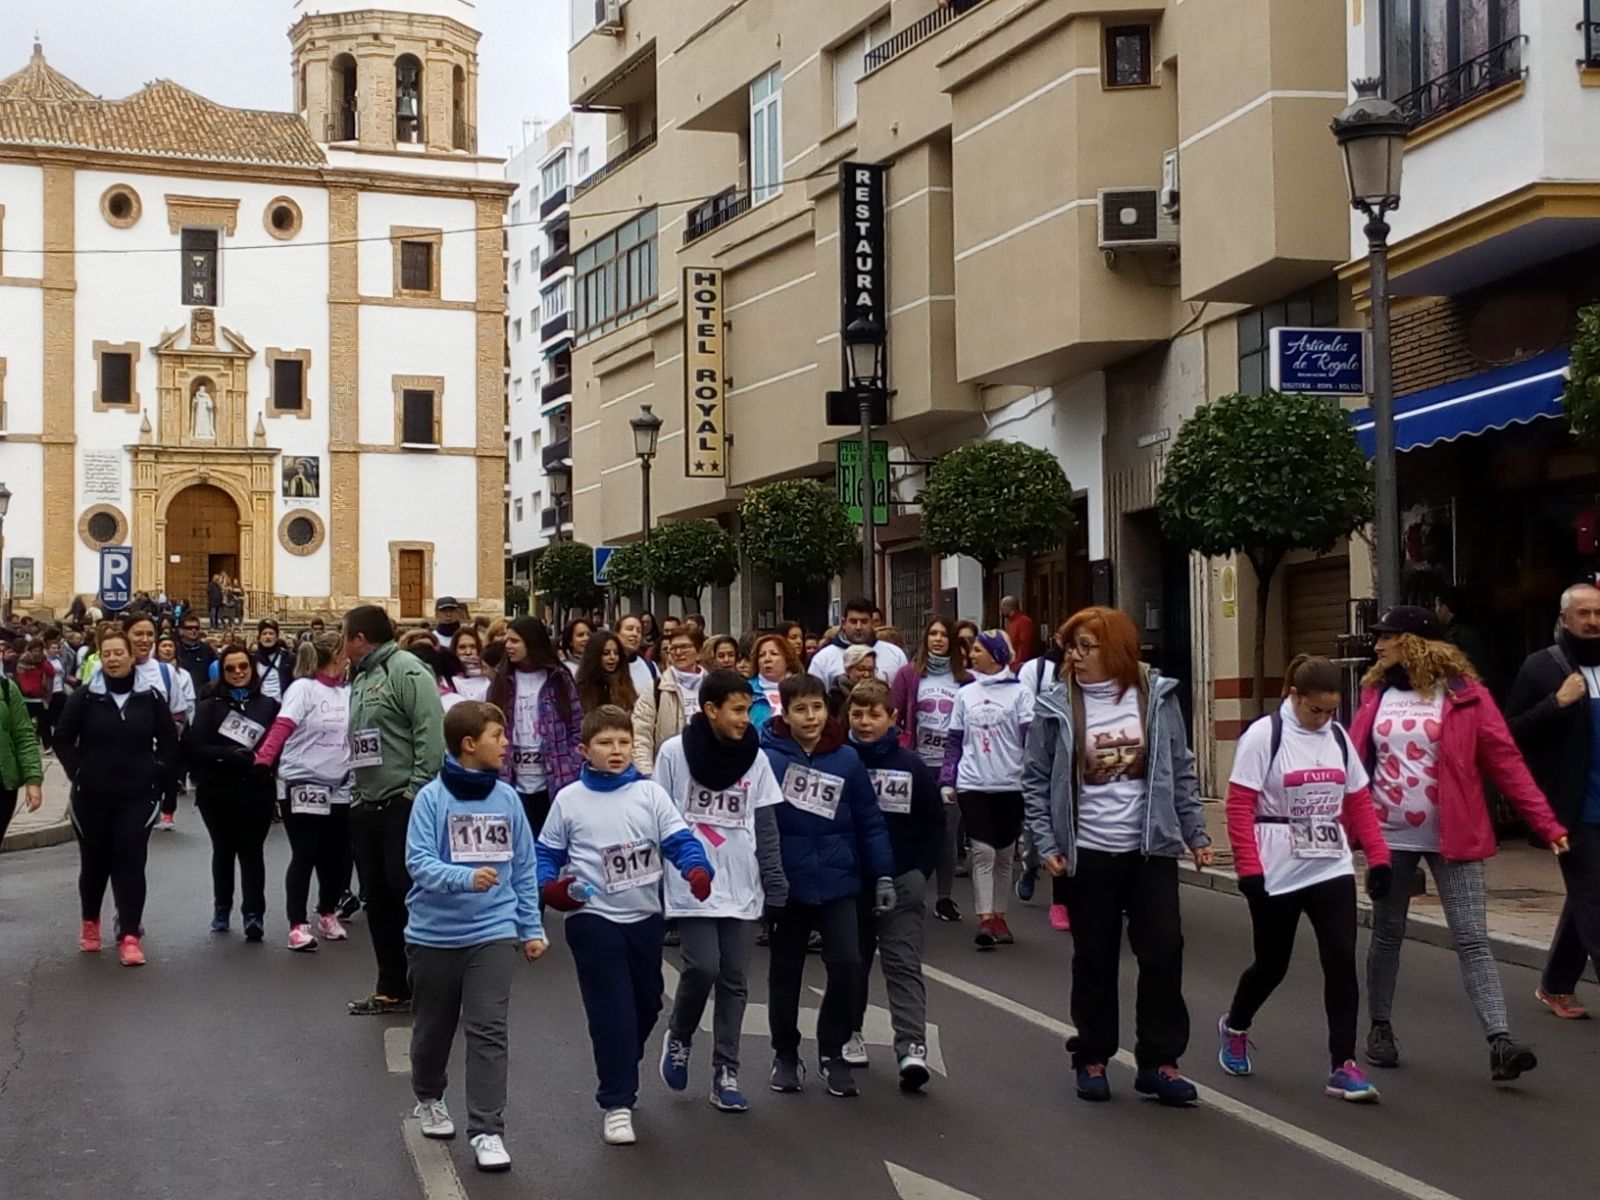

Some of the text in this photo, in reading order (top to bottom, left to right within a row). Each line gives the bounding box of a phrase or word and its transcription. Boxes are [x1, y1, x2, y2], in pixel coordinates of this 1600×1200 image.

[855, 169, 873, 320] RESTAURA
[694, 272, 718, 451] HOTEL ROYAL
[1292, 352, 1359, 377] de Regalo
[103, 554, 128, 589] P
[513, 751, 542, 765] 022
[299, 791, 327, 804] 023
[698, 790, 740, 813] 918
[793, 776, 836, 802] 915
[458, 826, 508, 845] 1143
[613, 848, 652, 874] 917
